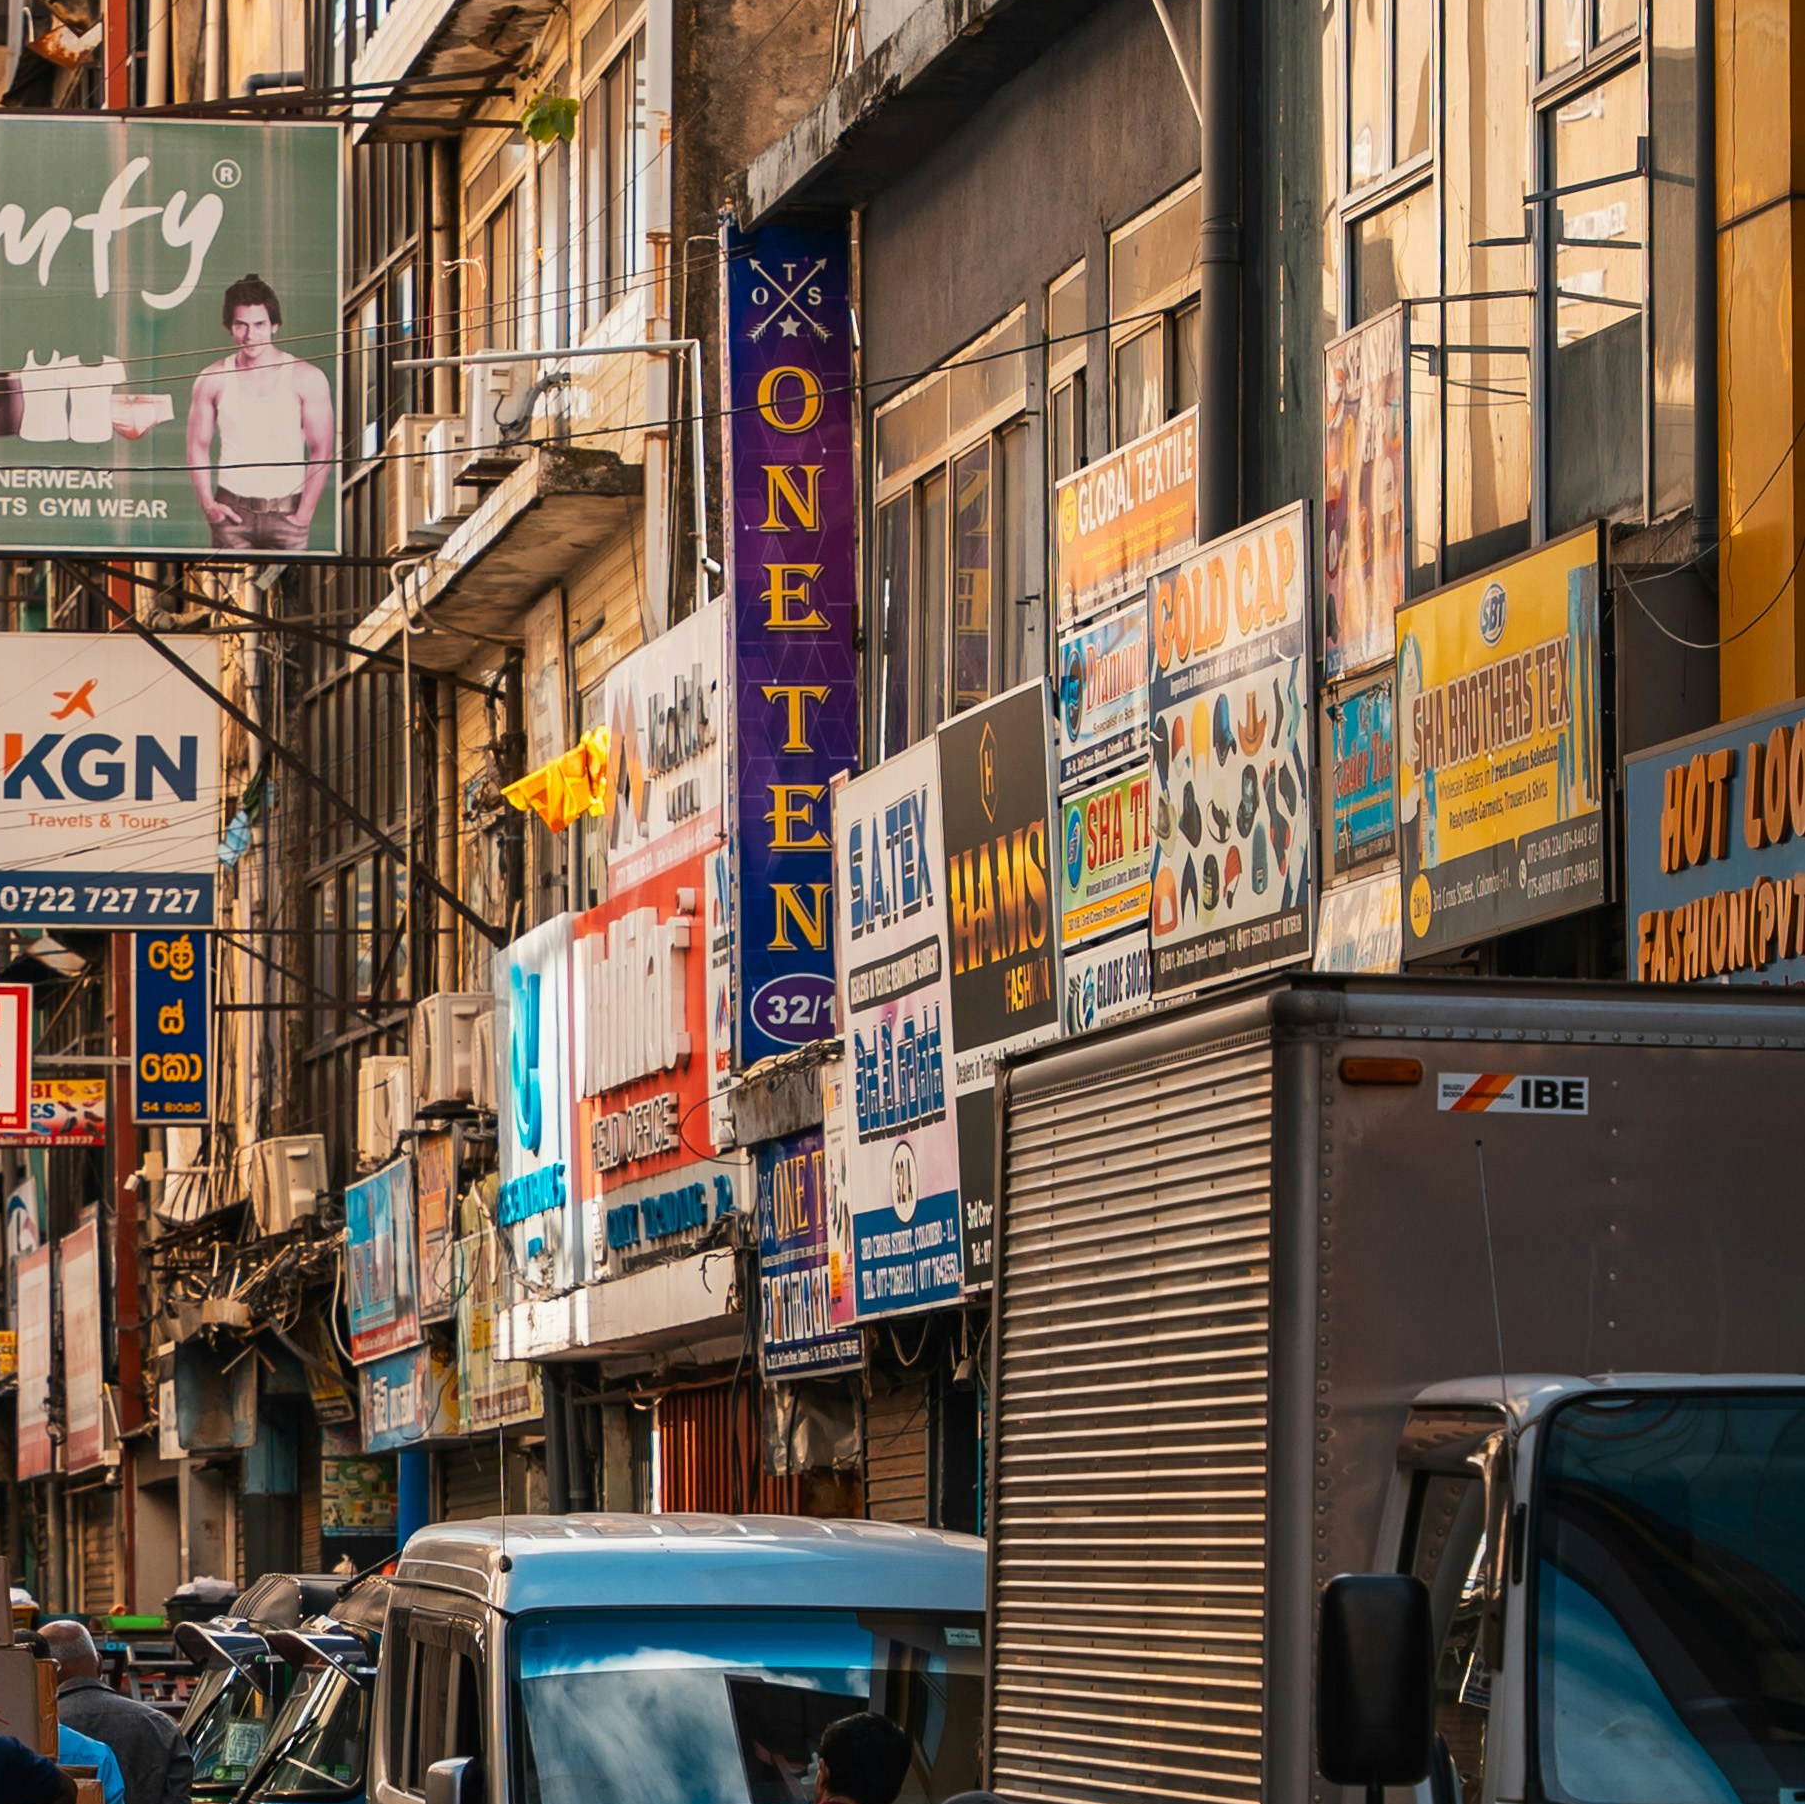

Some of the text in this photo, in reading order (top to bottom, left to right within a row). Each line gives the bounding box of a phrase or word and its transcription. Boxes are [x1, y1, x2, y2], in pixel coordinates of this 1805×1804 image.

[39, 496, 92, 518] GYM
[96, 497, 168, 520] WEAR
[1078, 451, 1135, 536] GLOBAL
[1136, 425, 1194, 506] TEXTILE
[1154, 556, 1229, 670] GOLD
[1234, 525, 1295, 635] CAP
[1482, 592, 1506, 635] SBT
[1412, 632, 1572, 781] SHA BROTHERS TEX
[3, 732, 198, 802] KGN
[1530, 742, 1558, 771] Selection
[28, 812, 170, 830] Travels & Tours
[1086, 787, 1124, 875] SHA
[1660, 748, 1734, 875] HOT
[0, 885, 76, 914] 0722
[84, 885, 144, 914] 727
[147, 886, 202, 915] 727
[949, 817, 1047, 976] HAMS
[1005, 955, 1051, 1014] FASHION
[1097, 955, 1125, 1011] GLOBE
[625, 1092, 679, 1163] OFFICE
[1521, 1079, 1585, 1110] IBE
[773, 1154, 810, 1241] ONE
